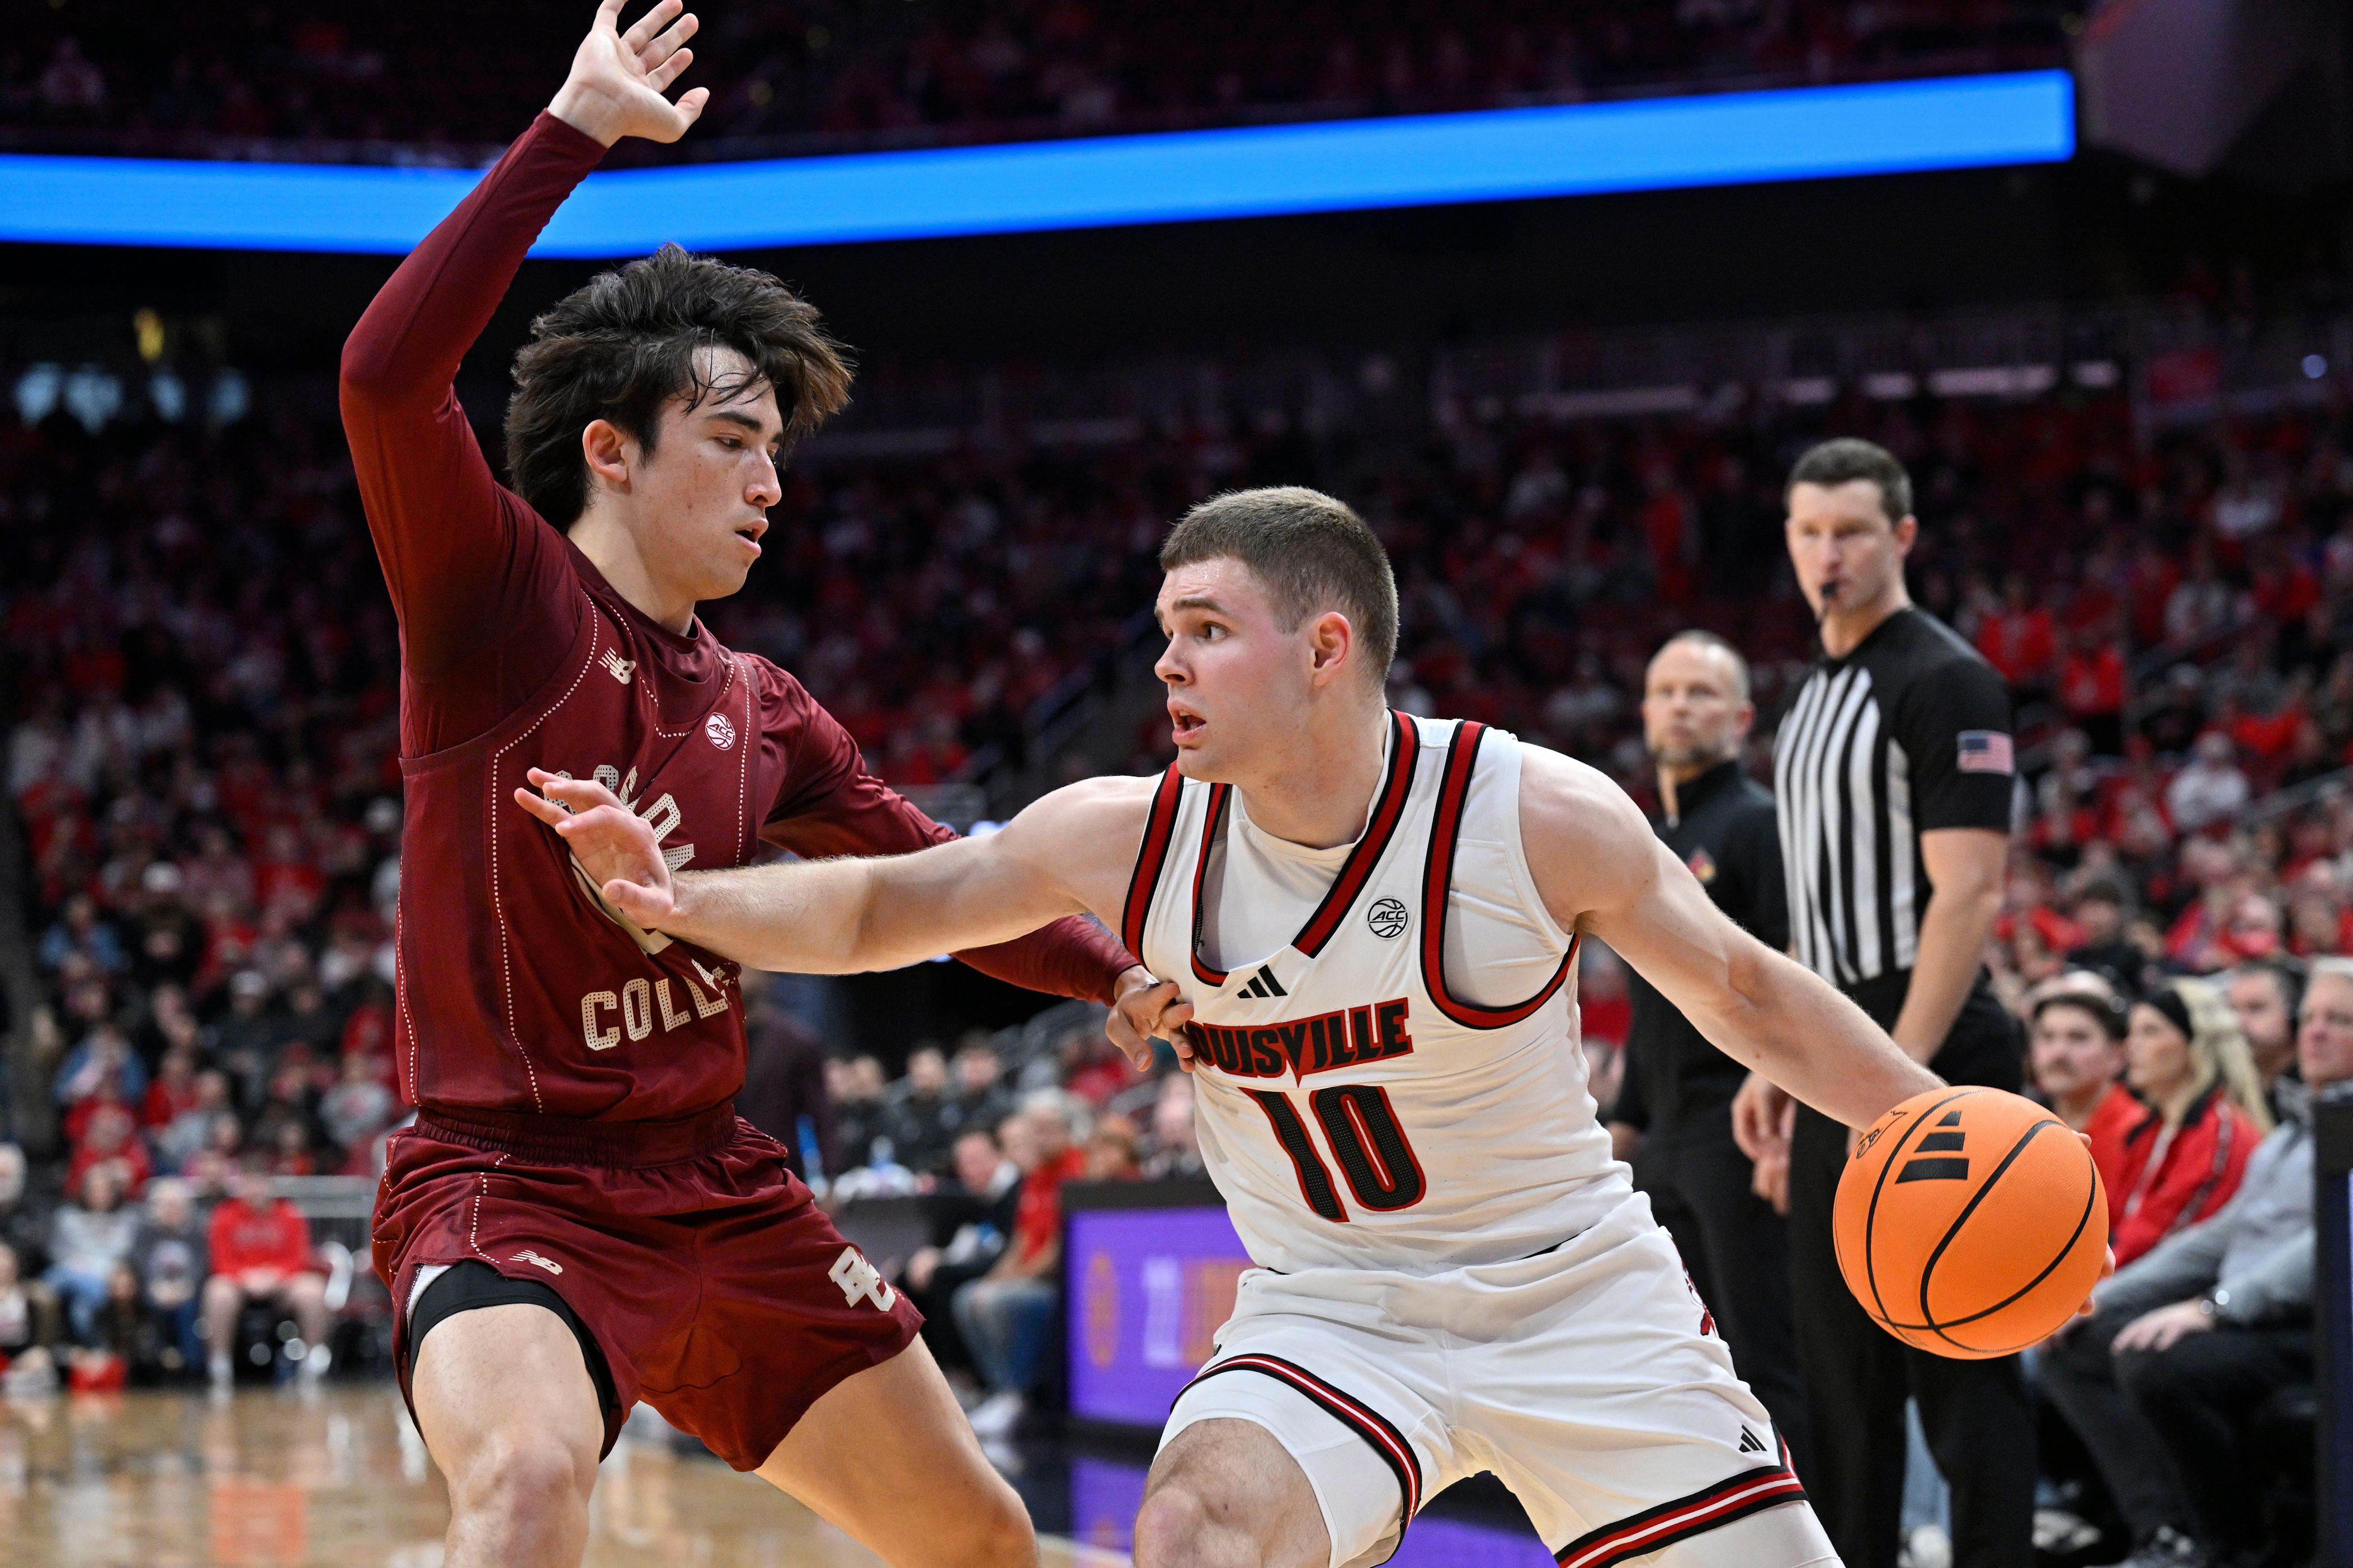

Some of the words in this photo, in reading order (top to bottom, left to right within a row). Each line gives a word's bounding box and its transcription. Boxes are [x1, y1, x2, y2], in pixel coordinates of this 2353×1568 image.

[708, 723, 734, 739] ACC
[1372, 910, 1407, 921] ACC
[1185, 997, 1414, 1088] OUISVILLE
[1237, 1084, 1427, 1223] 10
